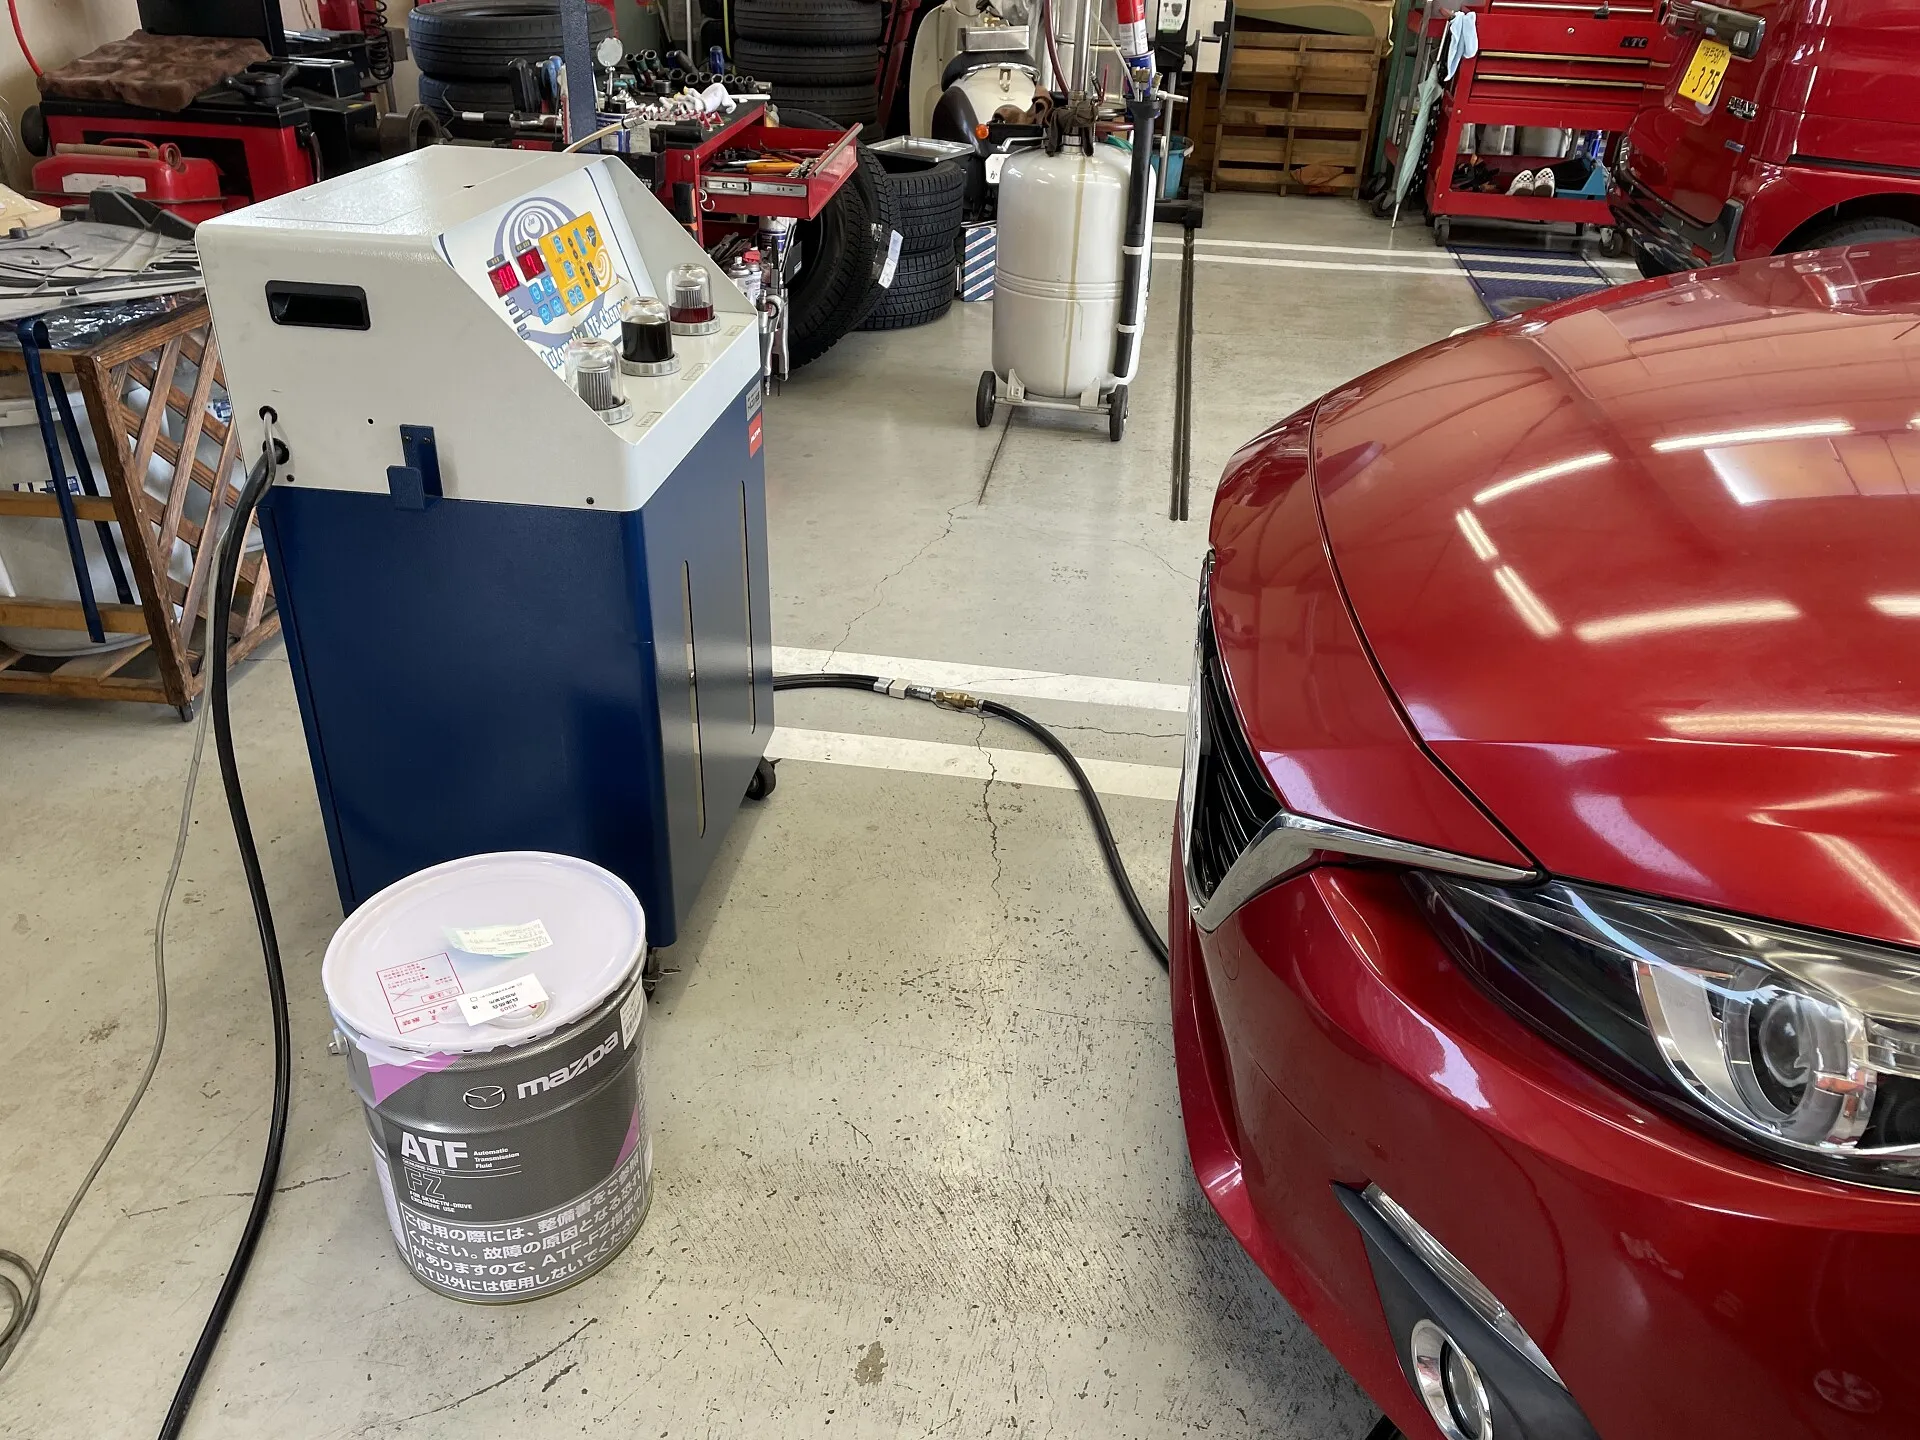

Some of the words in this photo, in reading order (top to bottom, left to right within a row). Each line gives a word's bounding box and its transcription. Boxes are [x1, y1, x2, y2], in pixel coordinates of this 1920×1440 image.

[516, 1030, 619, 1100] mazda
[401, 1131, 468, 1169] ATF
[473, 1147, 509, 1157] Automatic
[474, 1152, 520, 1163] Transmission
[475, 1161, 493, 1169] Fluid
[404, 1166, 446, 1200] FZ
[442, 1205, 456, 1213] USE
